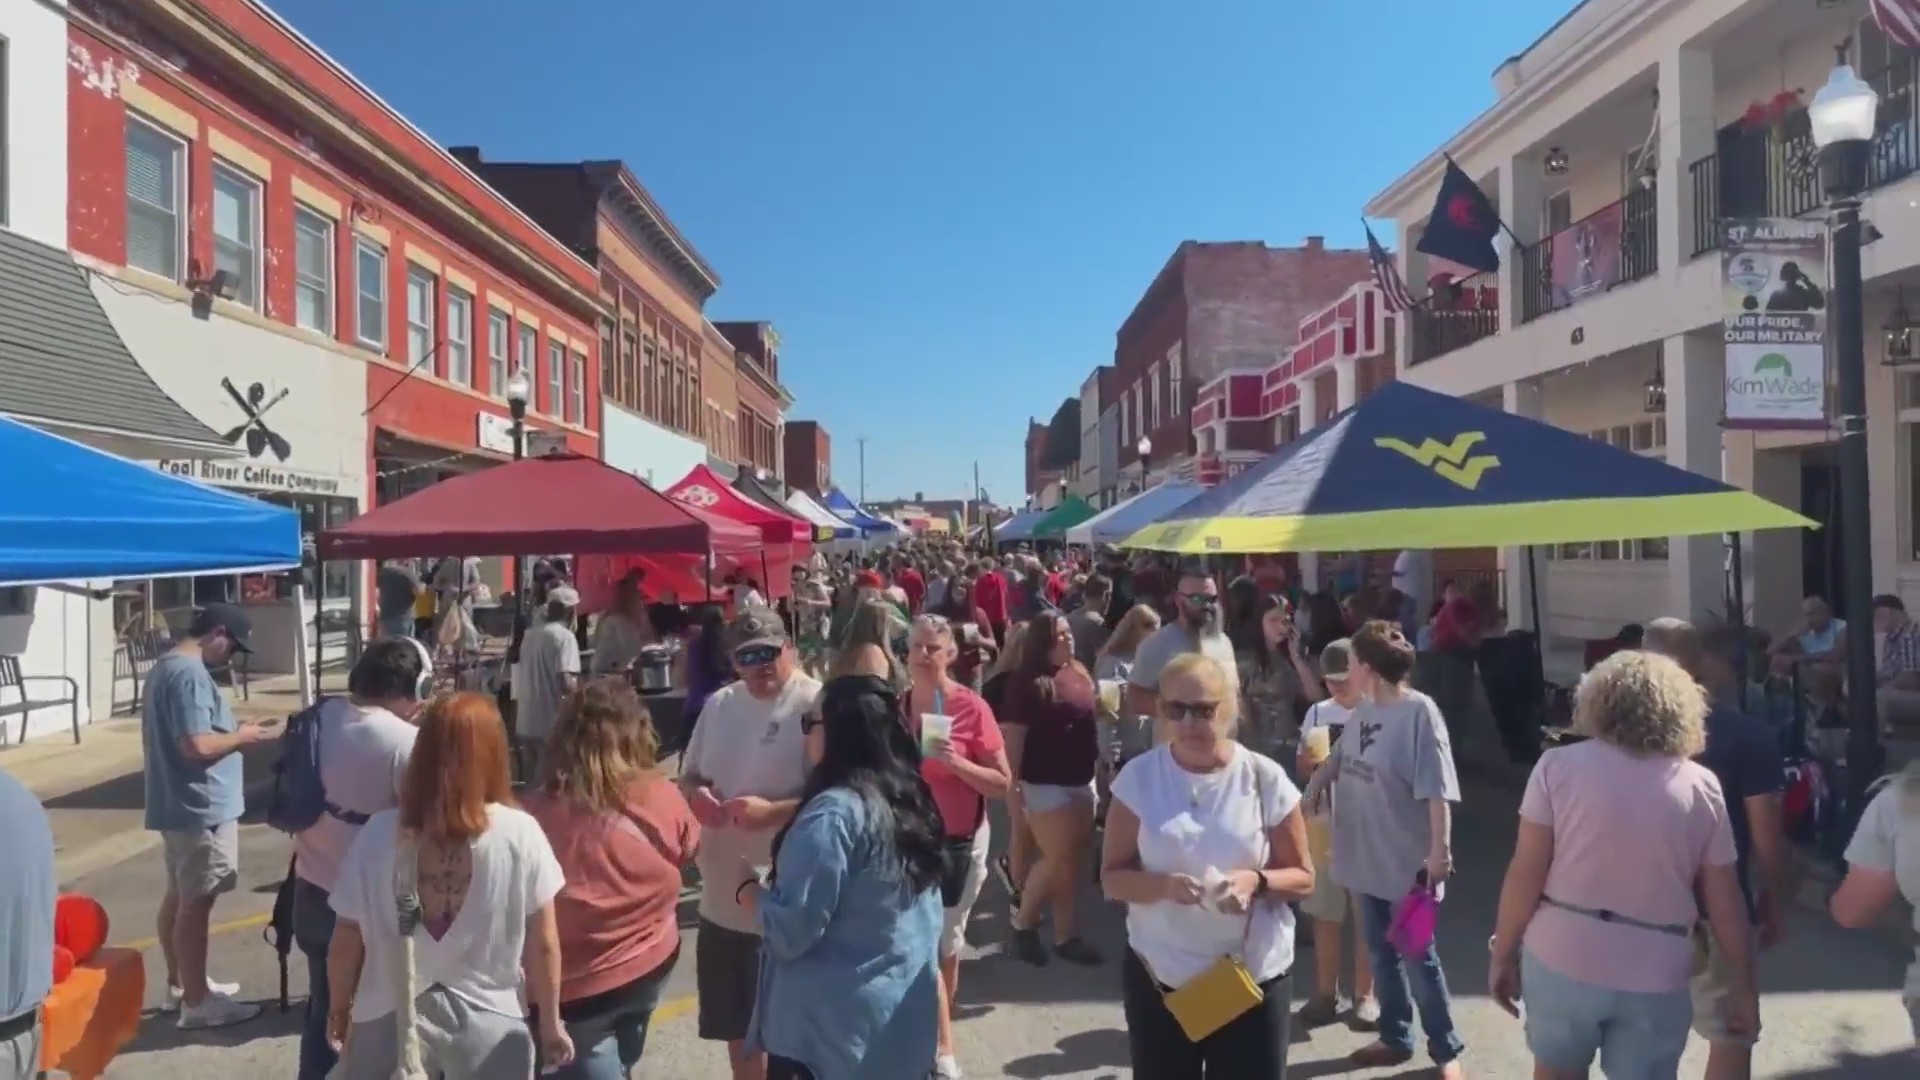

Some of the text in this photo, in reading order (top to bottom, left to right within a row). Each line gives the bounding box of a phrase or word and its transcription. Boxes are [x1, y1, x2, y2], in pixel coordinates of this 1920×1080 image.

[1753, 227, 1817, 239] ALS
[1724, 315, 1756, 329] OUR
[1724, 329, 1822, 342] OUR MILITARY
[159, 458, 339, 494] Coal River Coffee Company
